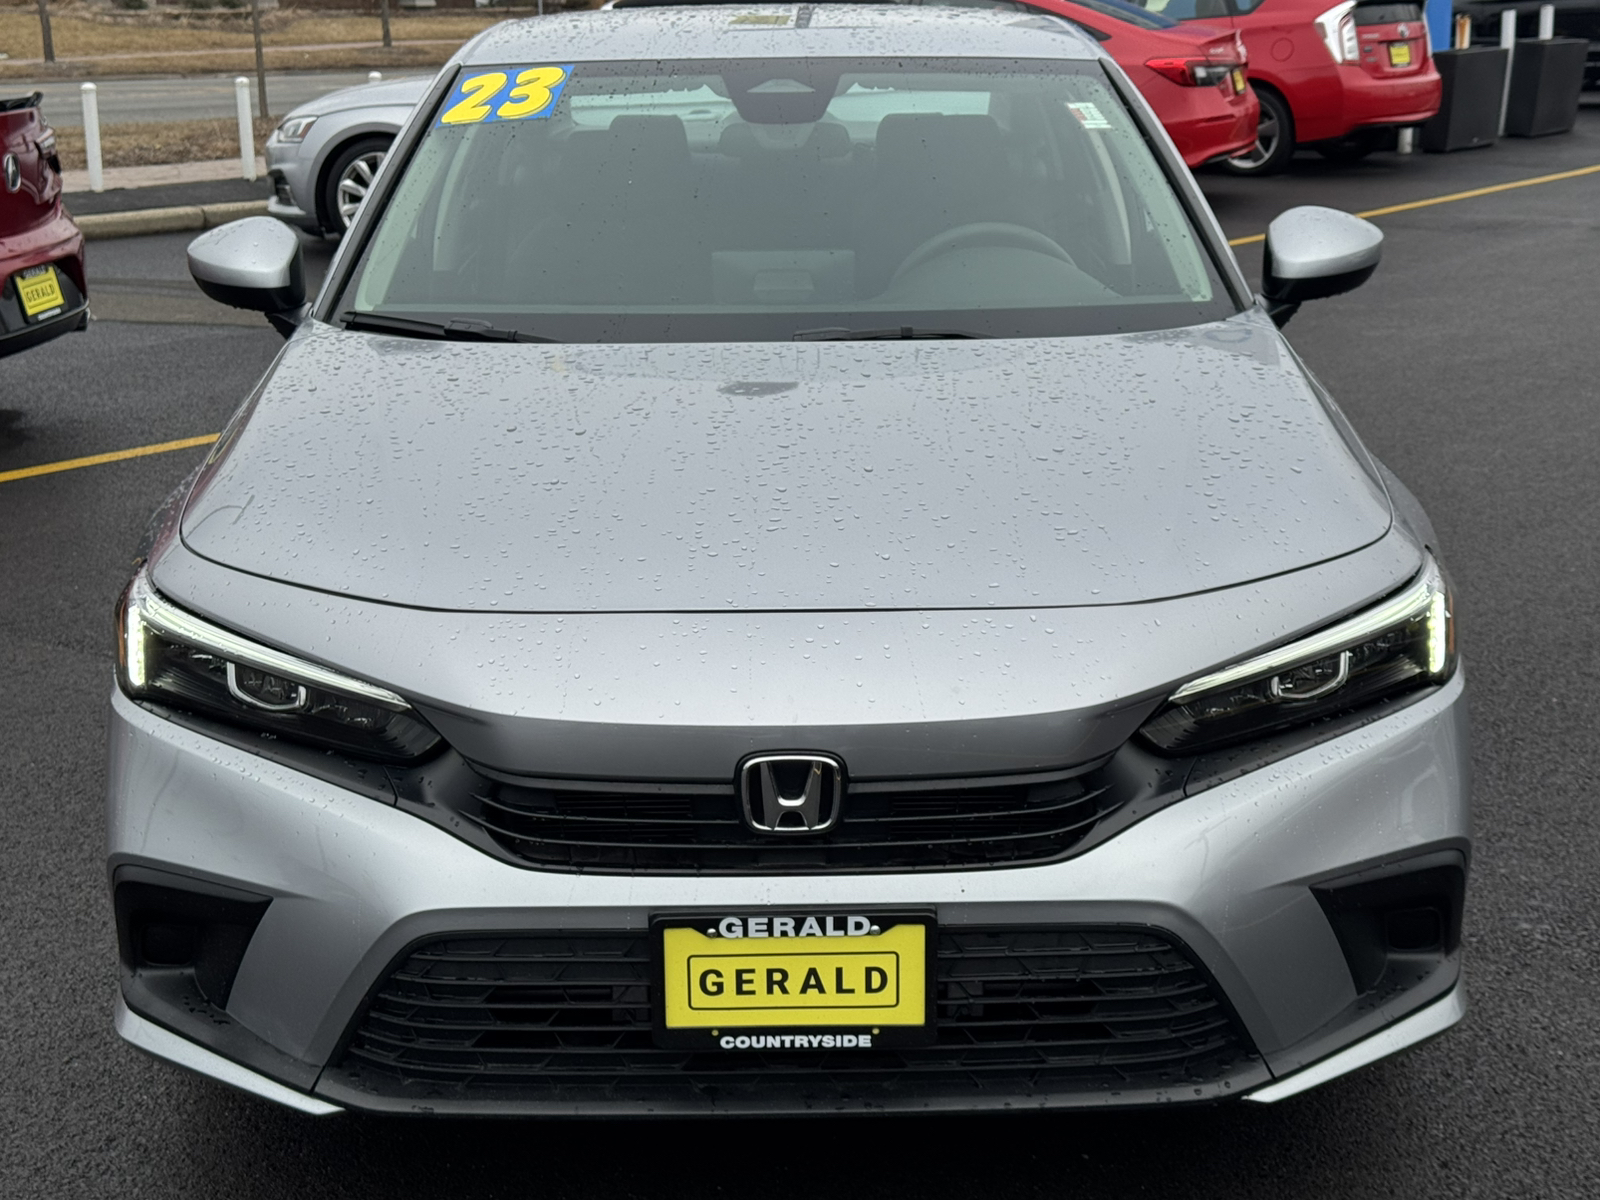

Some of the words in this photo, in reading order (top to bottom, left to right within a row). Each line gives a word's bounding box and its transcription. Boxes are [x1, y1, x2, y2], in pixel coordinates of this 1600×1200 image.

[441, 66, 566, 125] 23
[26, 283, 55, 302] GERALD
[719, 916, 871, 938] GERALD
[698, 966, 889, 996] GERALD
[720, 1034, 872, 1049] COUNTRYSIDE
